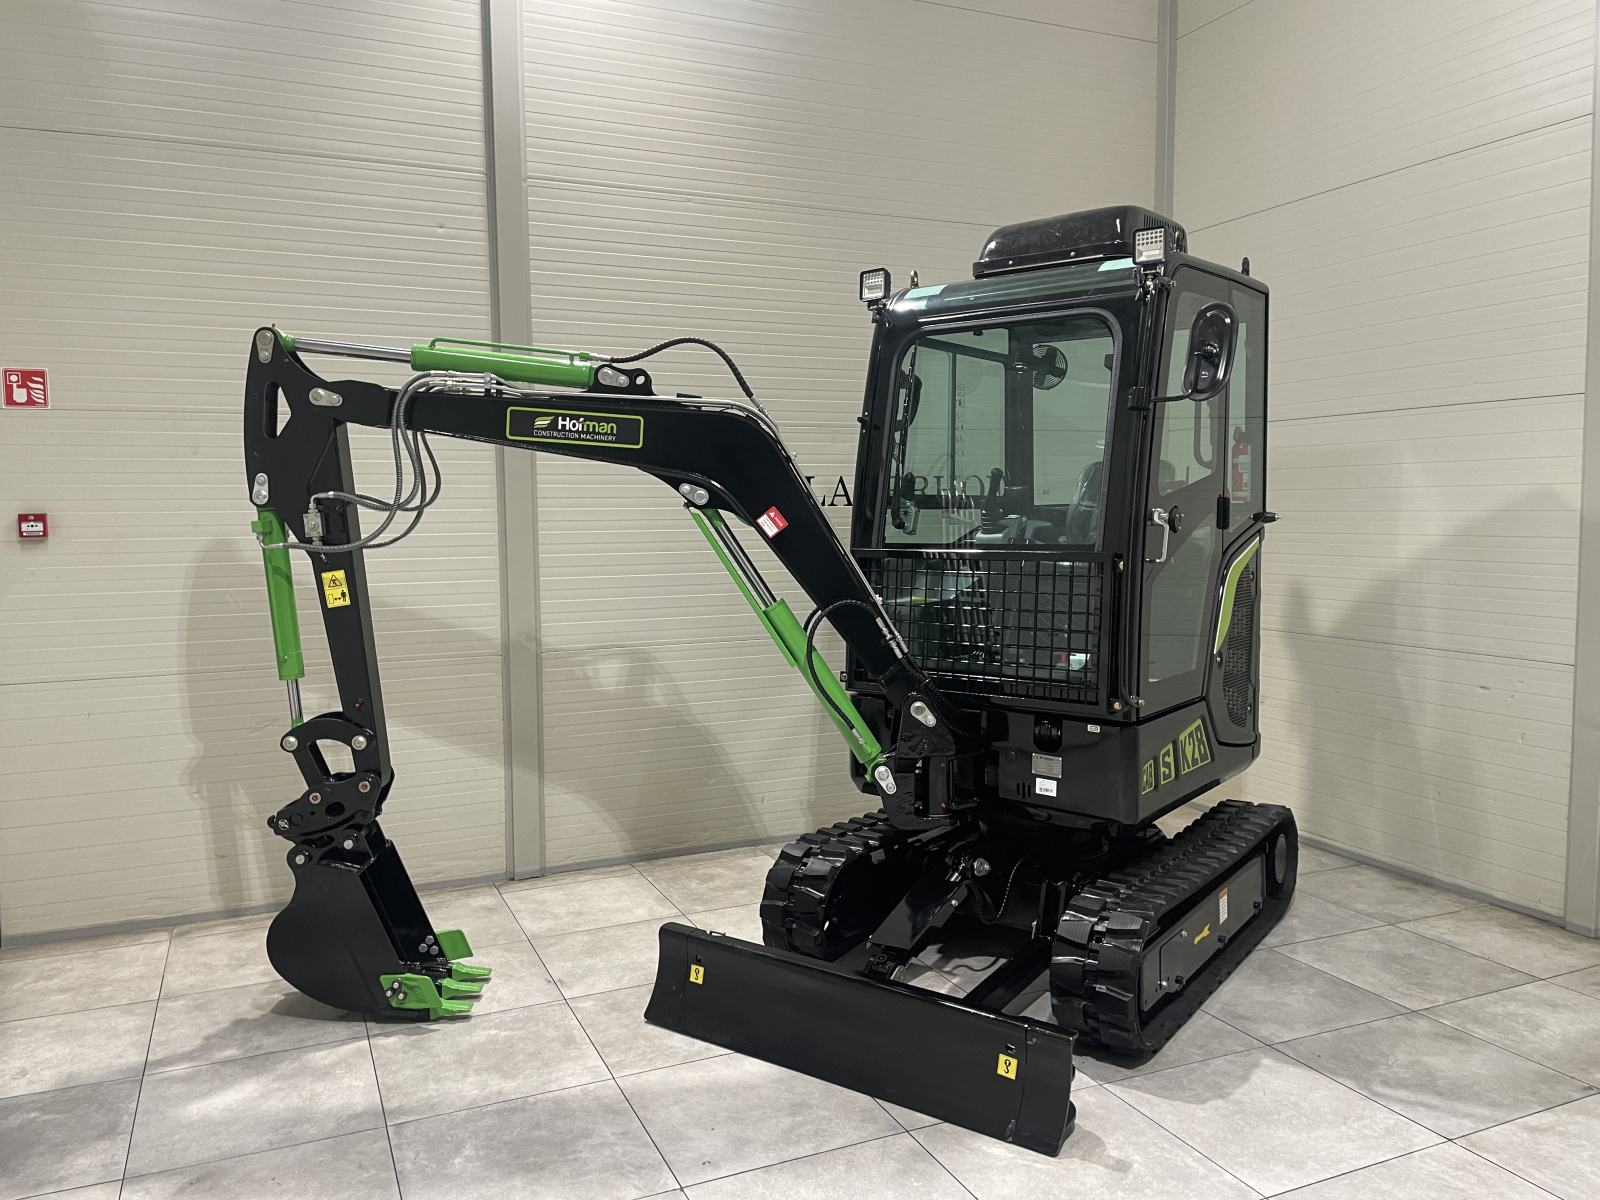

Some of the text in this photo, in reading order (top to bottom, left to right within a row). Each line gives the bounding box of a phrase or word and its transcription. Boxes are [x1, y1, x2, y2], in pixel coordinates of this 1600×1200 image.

[533, 429, 617, 442] CONSTRUCTION MACHINERY
[1161, 745, 1173, 783] S
